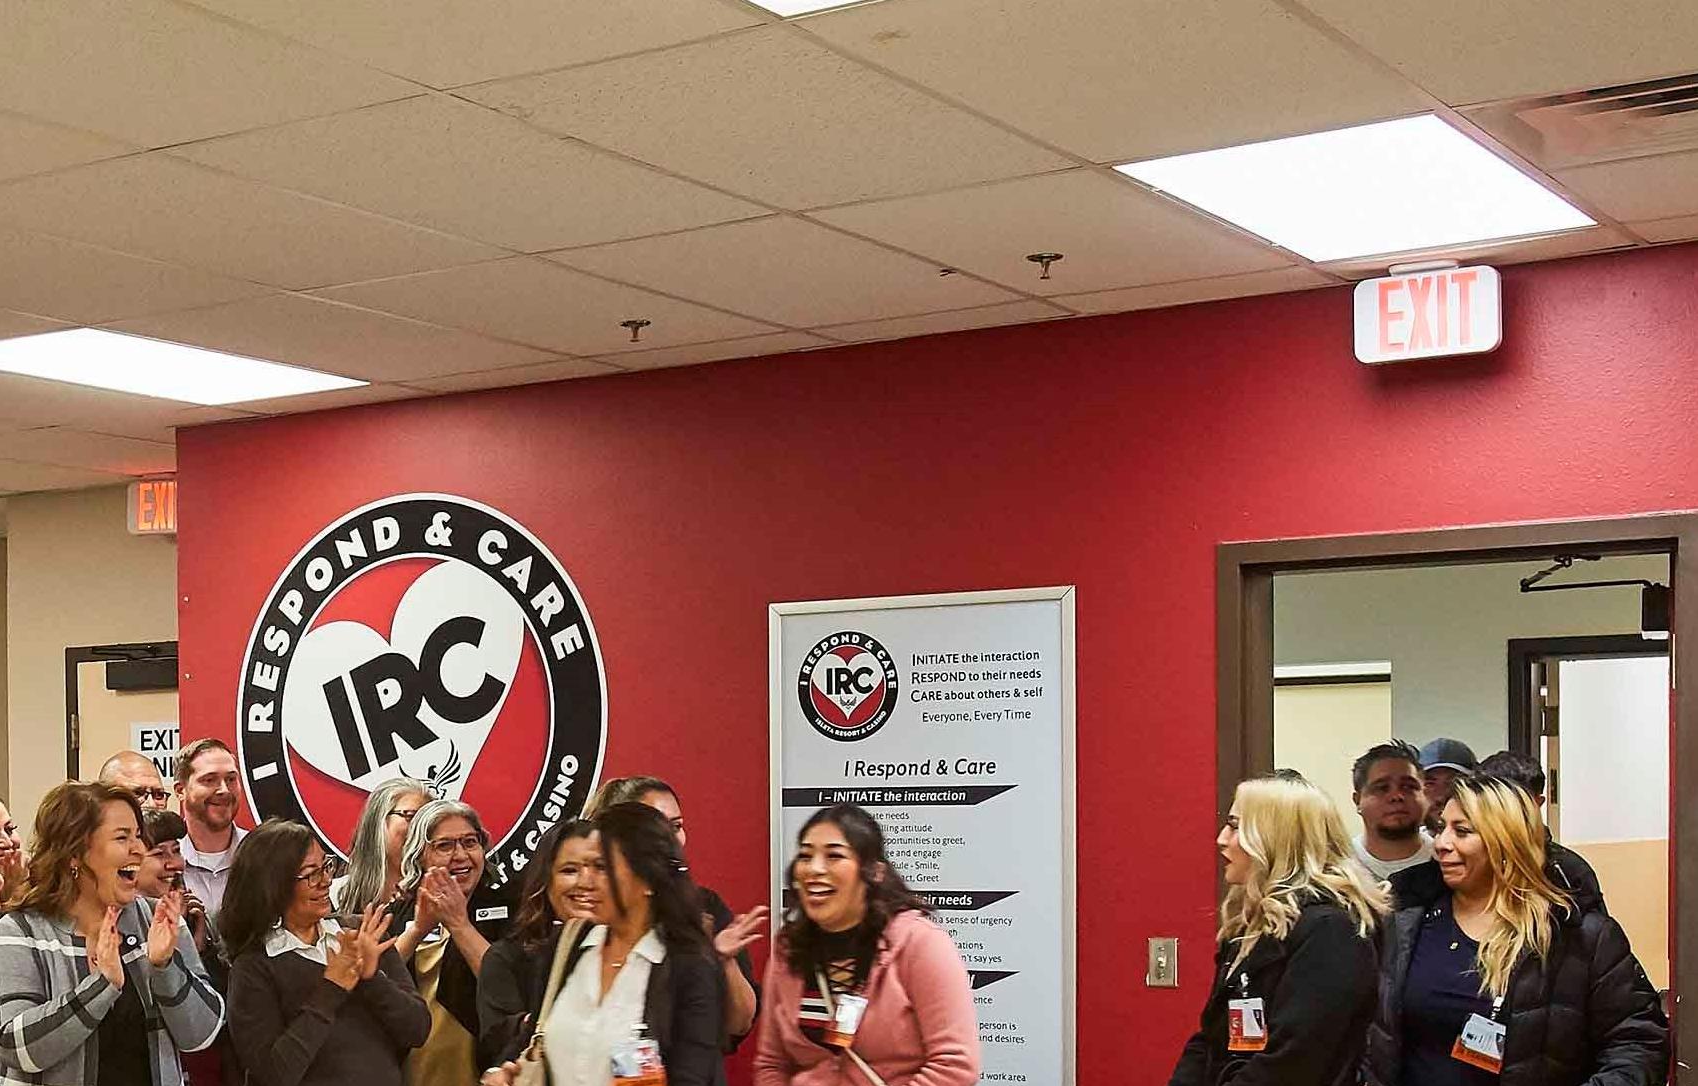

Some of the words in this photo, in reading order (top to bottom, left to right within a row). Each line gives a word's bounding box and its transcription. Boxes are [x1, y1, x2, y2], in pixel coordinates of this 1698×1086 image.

[1377, 270, 1478, 353] EXIT
[138, 481, 177, 531] EXI
[424, 512, 452, 547] &
[477, 529, 585, 660] CARE
[247, 515, 400, 733] RESPOND
[802, 634, 860, 675] RESPOND
[865, 640, 874, 650] &
[876, 650, 897, 689] CARE
[912, 653, 959, 666] INITIATE
[962, 653, 978, 663] the
[981, 651, 1040, 662] interaction
[826, 667, 874, 695] IRC
[911, 671, 966, 684] RESPOND
[968, 672, 980, 681] to
[982, 670, 1007, 680] their
[1009, 669, 1042, 679] needs
[322, 615, 506, 782] IRC
[910, 690, 942, 702] CARE
[944, 690, 975, 700] about
[977, 688, 1010, 699] others
[1013, 688, 1020, 698] &
[1023, 687, 1043, 697] self
[922, 712, 972, 723] Everyone,
[974, 711, 1002, 722] Every
[1004, 709, 1031, 720] Time
[252, 760, 279, 781] I
[844, 760, 850, 777] I
[854, 759, 931, 780] Respond
[936, 759, 948, 775] &
[954, 758, 997, 775] Care
[818, 792, 823, 803] I
[833, 791, 882, 802] INITIATE
[883, 791, 902, 802] the
[904, 790, 966, 801] interaction
[510, 849, 530, 871] &
[525, 753, 579, 852] CASINO
[886, 812, 910, 820] needs
[900, 825, 933, 833] attitude
[883, 837, 930, 846] pportunities
[913, 850, 942, 859] engage
[916, 873, 939, 882] Greet
[938, 894, 972, 905] needs
[970, 916, 979, 924] of
[980, 917, 1013, 926] urgency
[974, 955, 987, 964] say
[988, 955, 1002, 964] yes
[979, 1022, 1007, 1031] person
[1009, 1022, 1017, 1031] is
[994, 1035, 1025, 1044] desires
[986, 1072, 1007, 1081] work
[1008, 1074, 1026, 1082] area
